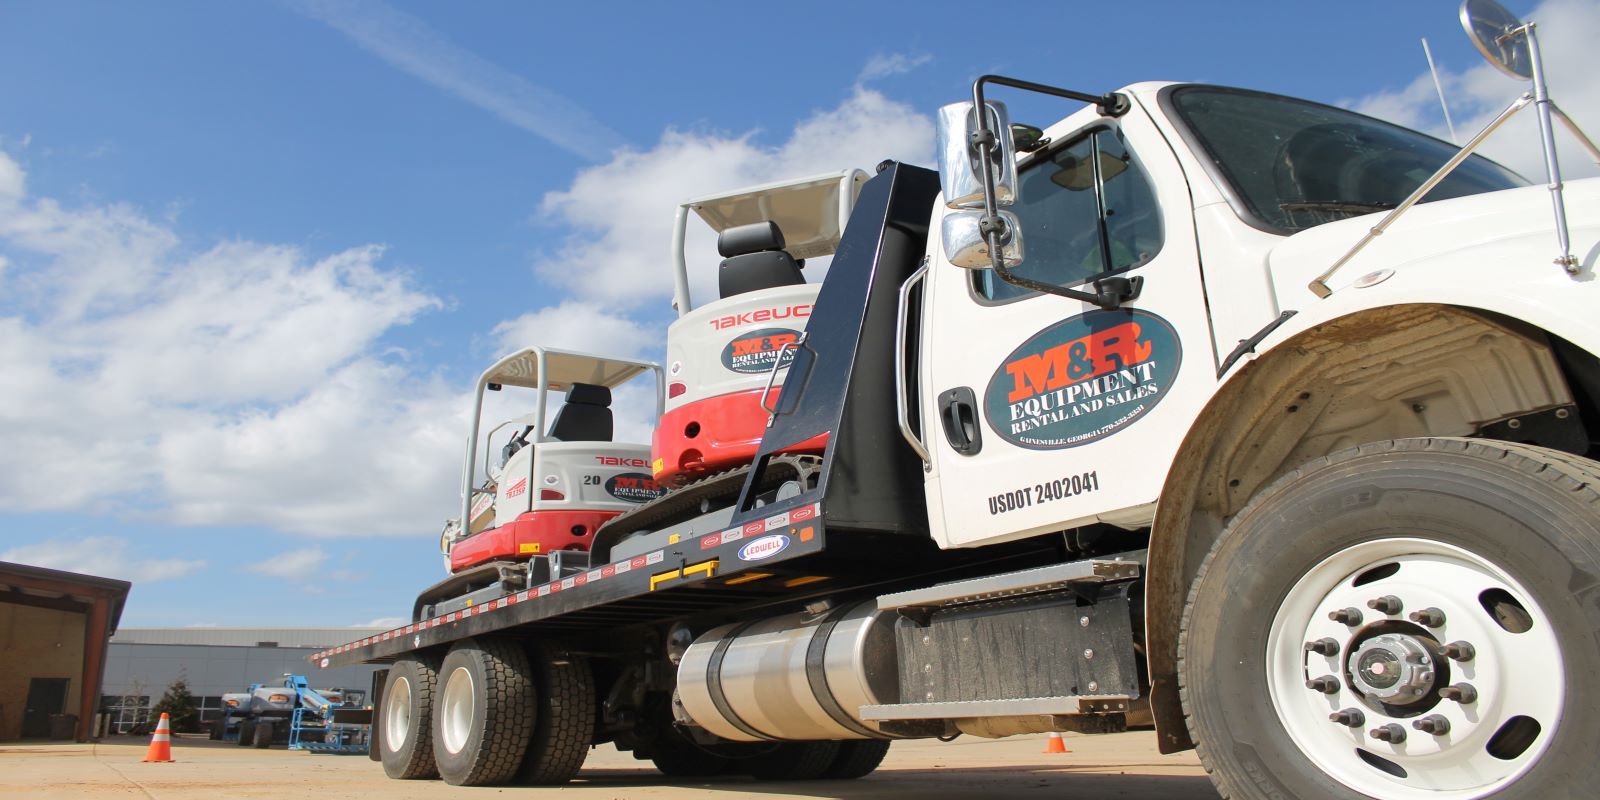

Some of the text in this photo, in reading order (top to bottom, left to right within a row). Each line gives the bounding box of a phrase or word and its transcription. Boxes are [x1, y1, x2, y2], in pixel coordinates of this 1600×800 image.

[1006, 322, 1153, 403] M&R
[1008, 361, 1156, 421] EQUIPMENT
[1011, 382, 1159, 435] RENTAL AND SALES
[1067, 428, 1101, 444] GEORGIA
[583, 475, 601, 485] 20
[988, 470, 1099, 515] USDOT 2402041
[746, 540, 780, 555] LEDWELL
